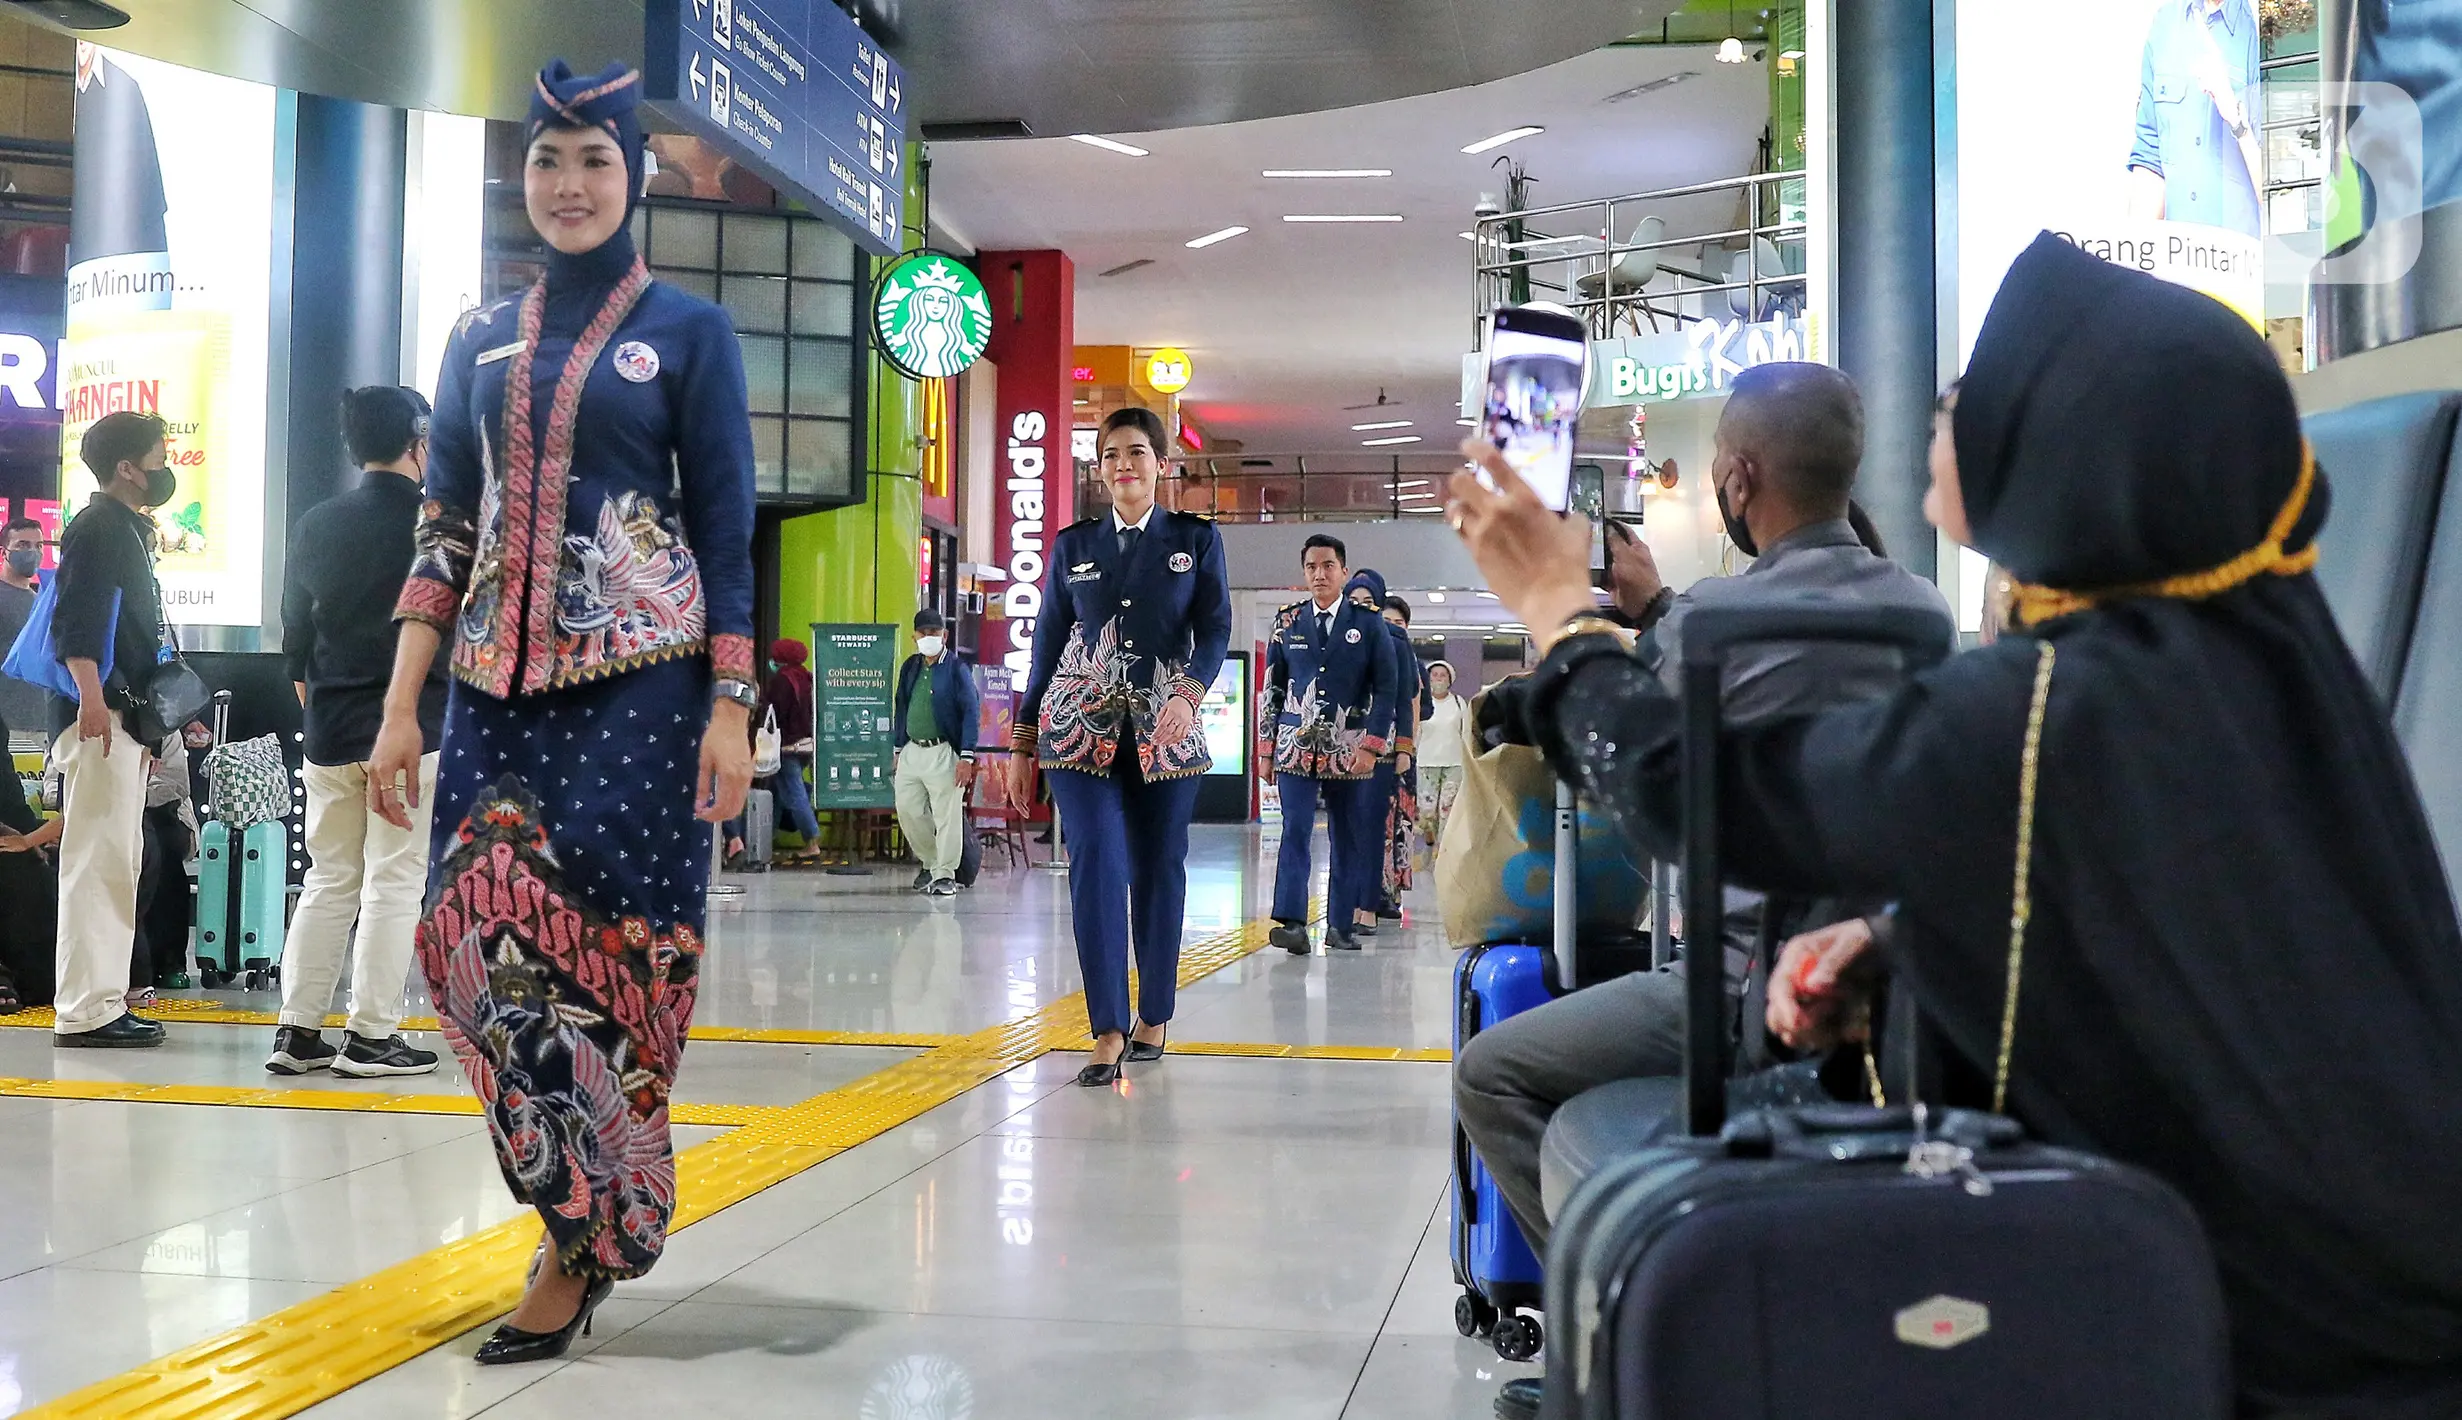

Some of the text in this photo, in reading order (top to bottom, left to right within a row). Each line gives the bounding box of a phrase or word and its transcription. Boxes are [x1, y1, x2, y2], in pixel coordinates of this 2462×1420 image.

[735, 6, 805, 81] Loket Penjualan Langsung
[857, 42, 871, 67] Toilet
[735, 34, 743, 51] Go
[756, 50, 769, 72] Ticket
[769, 62, 787, 86] Counter
[734, 82, 783, 134] Konter Pelaporan
[856, 111, 868, 132] ATM
[754, 126, 772, 150] Counter
[829, 156, 842, 180] Hotel
[852, 173, 867, 198] Transit
[2169, 236, 2239, 274] Pintar
[1003, 410, 1047, 694] McDonald's
[831, 634, 877, 642] STARBUCKS
[825, 678, 886, 689] with every sip
[828, 668, 883, 677] Collect Stars
